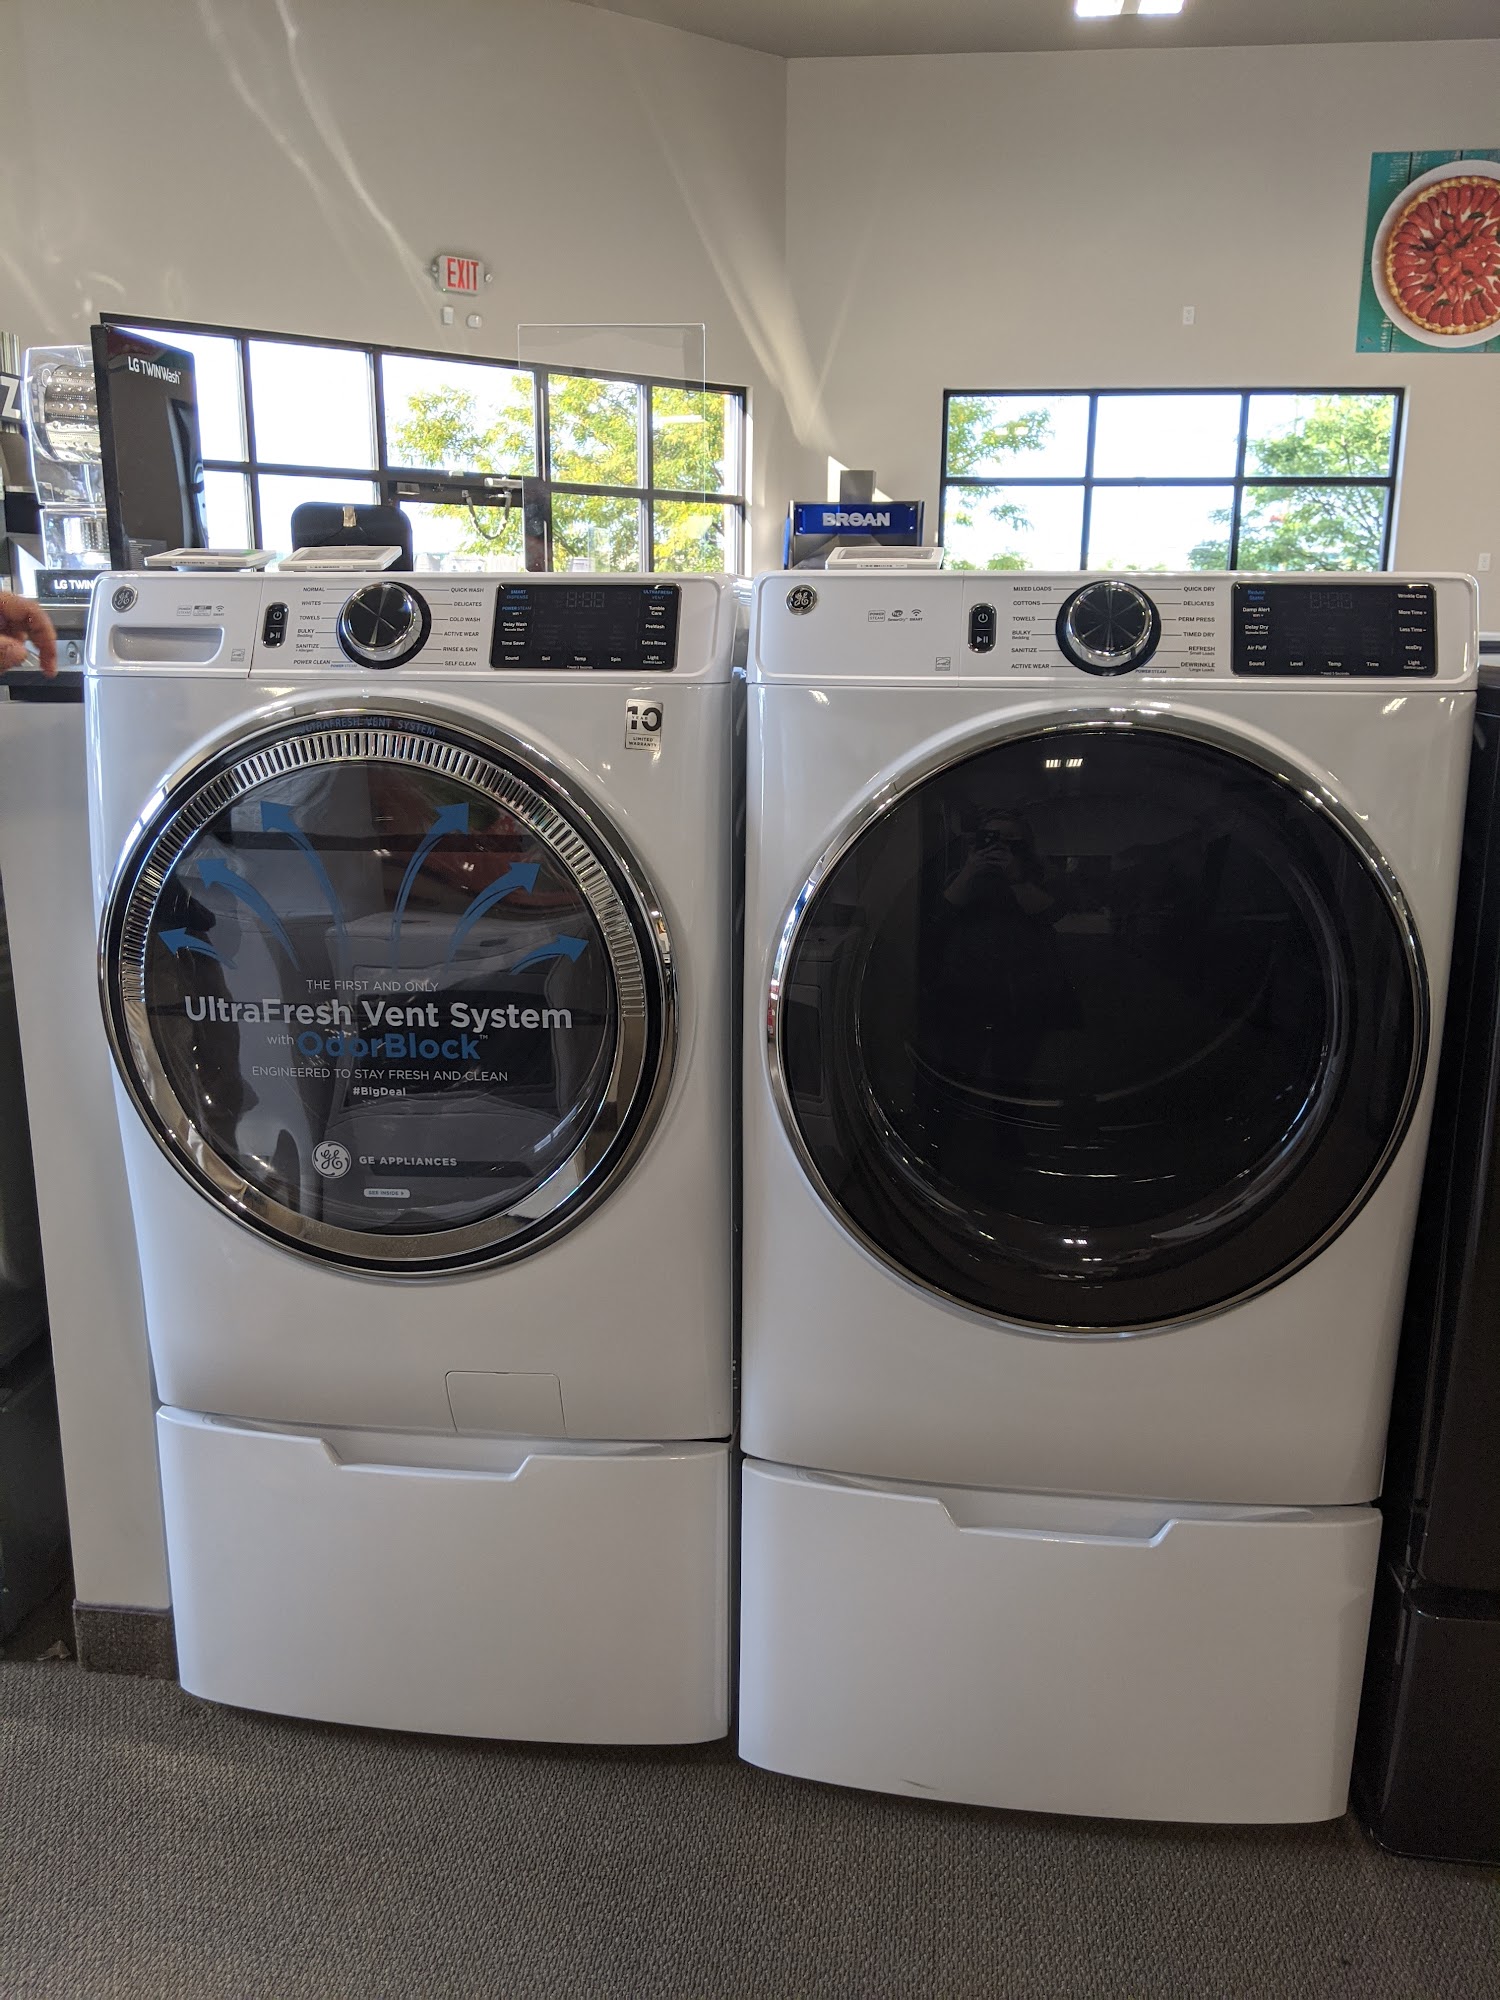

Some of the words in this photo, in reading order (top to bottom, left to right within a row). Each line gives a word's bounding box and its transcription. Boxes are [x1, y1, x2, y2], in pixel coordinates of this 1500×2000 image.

[446, 257, 479, 291] EXIT
[127, 356, 140, 373] LG
[822, 512, 891, 527] BROAN
[53, 579, 68, 590] LG
[366, 717, 392, 729] VENT
[397, 720, 437, 736] SYSTEM
[627, 705, 662, 732] 10
[306, 979, 331, 990] THE
[334, 980, 369, 991] FIRST
[373, 981, 401, 992] AND
[404, 981, 439, 993] ONLY
[184, 994, 352, 1026] UltraFresh
[361, 1000, 440, 1028] Vent
[450, 1002, 573, 1033] System
[267, 1034, 295, 1045] with
[252, 1065, 330, 1078] ENGINEERED
[333, 1068, 351, 1079] TO
[354, 1068, 385, 1080] STAY
[388, 1069, 430, 1080] FRESH
[433, 1070, 462, 1081] AND
[465, 1070, 509, 1082] CLEAN
[352, 1086, 406, 1097] #BigDeal
[359, 1155, 376, 1165] GE
[379, 1156, 458, 1167] APPLIANCES
